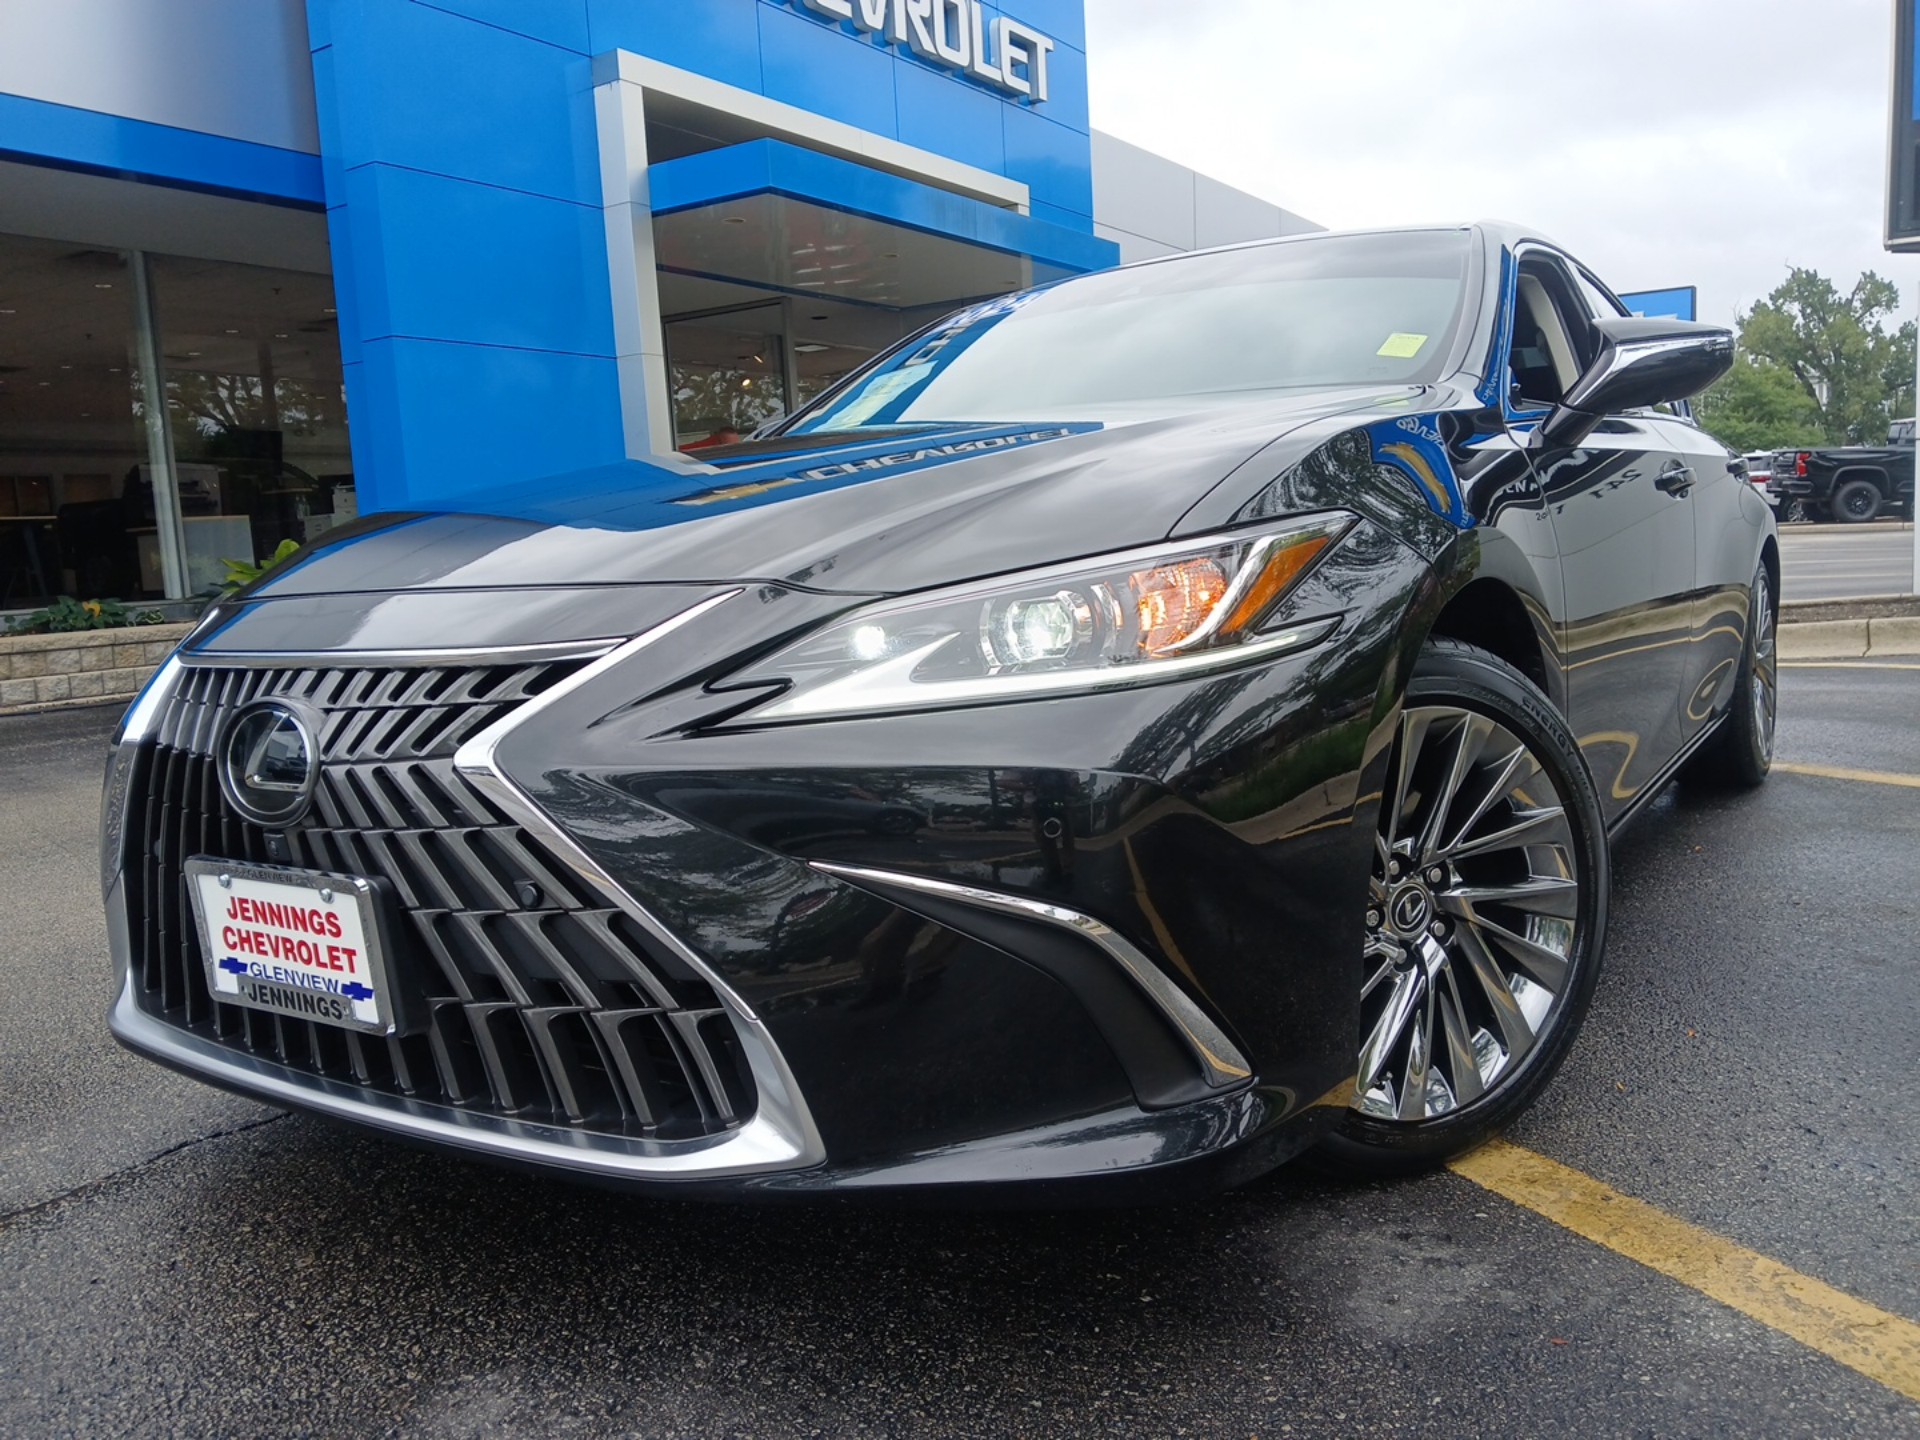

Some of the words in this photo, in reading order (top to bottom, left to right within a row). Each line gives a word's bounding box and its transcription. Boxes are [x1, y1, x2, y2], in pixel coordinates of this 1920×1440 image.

[1521, 696, 1575, 757] ENERGY
[227, 896, 343, 938] JENNINGS
[222, 926, 357, 974] CHEVROLET
[250, 962, 340, 994] GLENVIEW
[248, 983, 343, 1020] JENNINGS
